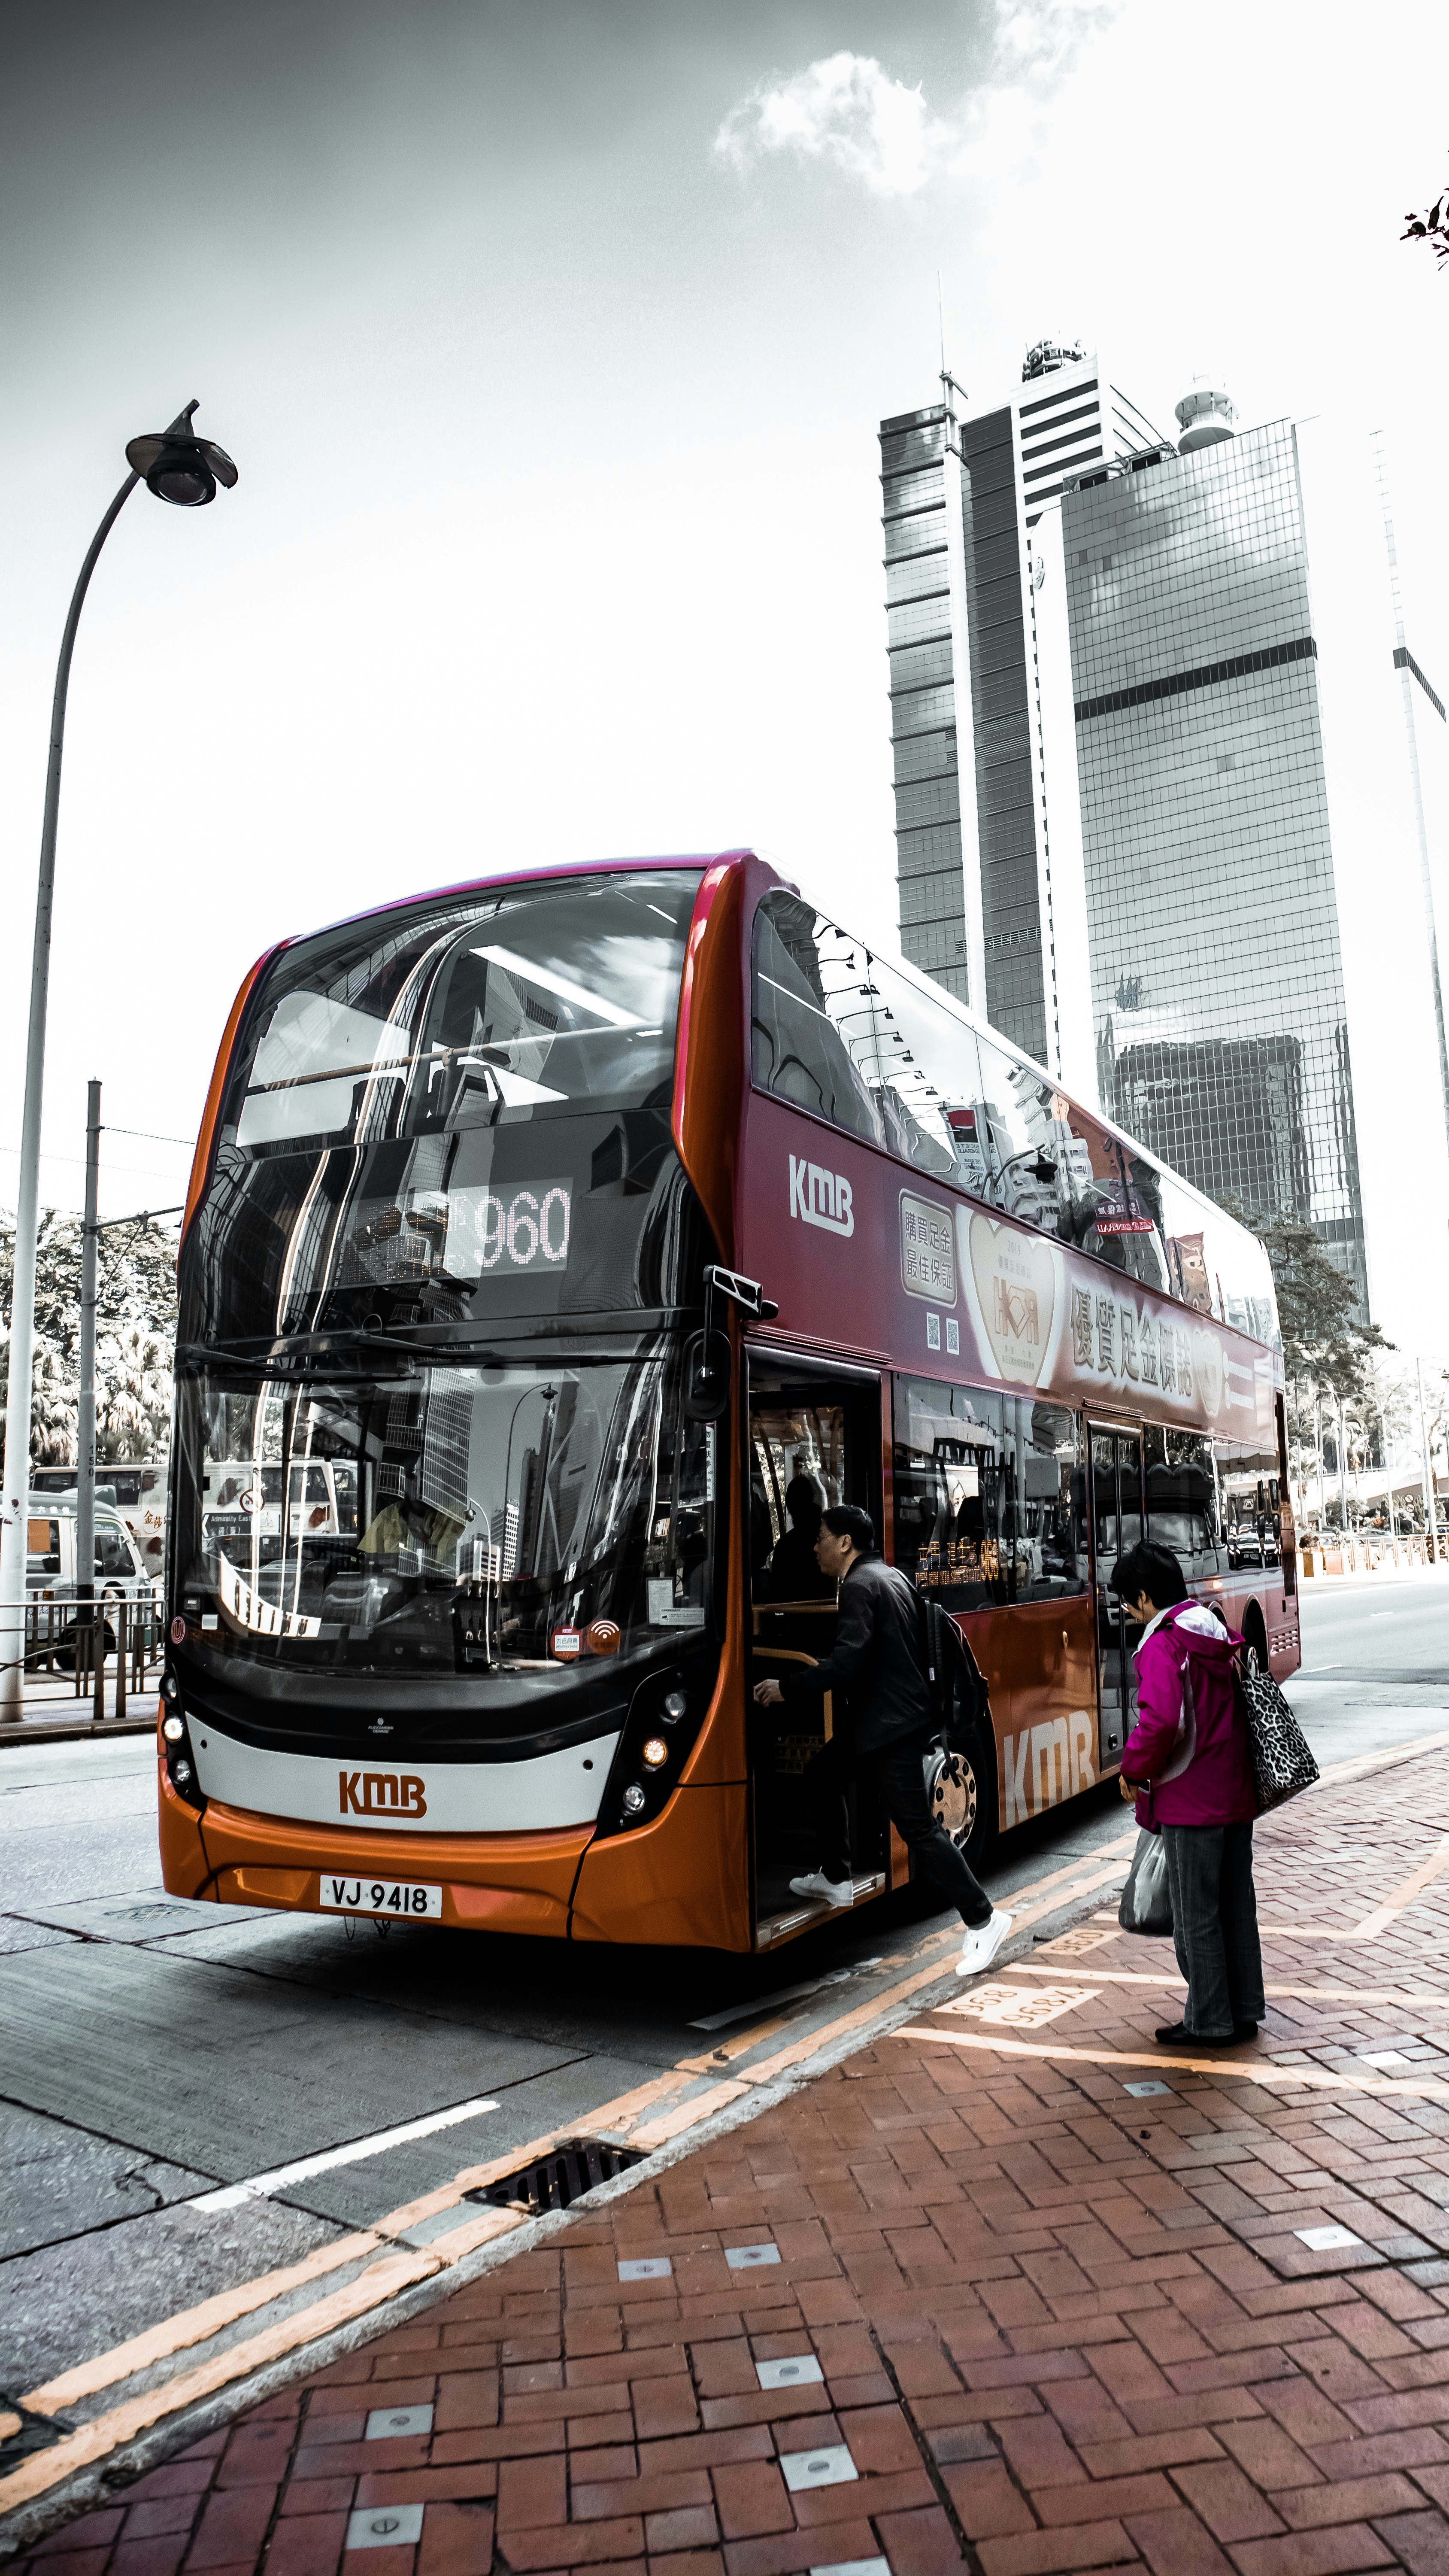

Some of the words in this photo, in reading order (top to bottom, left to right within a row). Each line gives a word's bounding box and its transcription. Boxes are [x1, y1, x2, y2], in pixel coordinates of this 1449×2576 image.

[789, 1154, 855, 1237] KMB
[474, 1188, 570, 1267] 960
[905, 1211, 950, 1254] 購買足金
[906, 1249, 952, 1290] 最佳保証
[1003, 1710, 1096, 1828] KMB
[339, 1771, 427, 1819] KMB
[332, 1879, 361, 1906] VJ
[370, 1883, 428, 1913] 9418
[1050, 1932, 1105, 1951] 960
[951, 1990, 1018, 2011] 968
[1001, 1990, 1085, 2023] 968X
